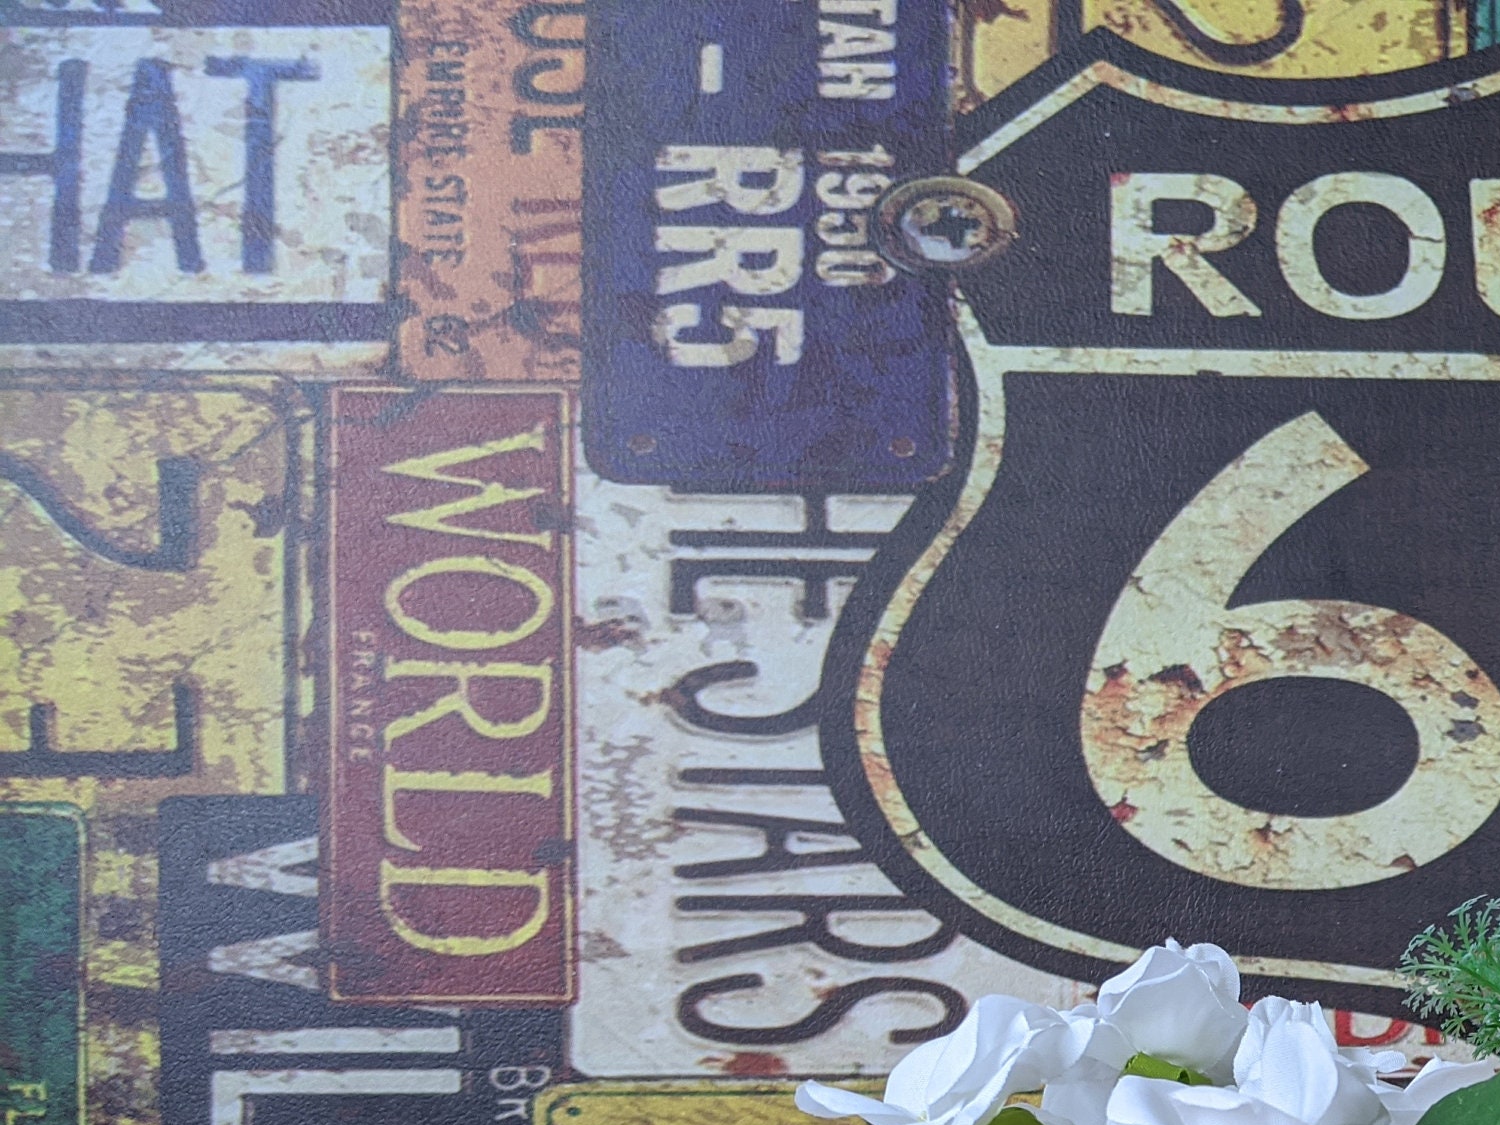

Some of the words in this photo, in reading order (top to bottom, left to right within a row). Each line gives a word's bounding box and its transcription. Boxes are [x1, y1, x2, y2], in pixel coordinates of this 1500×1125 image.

[424, 175, 470, 269] STATE
[815, 143, 896, 286] 1950
[382, 419, 554, 956] WORLD
